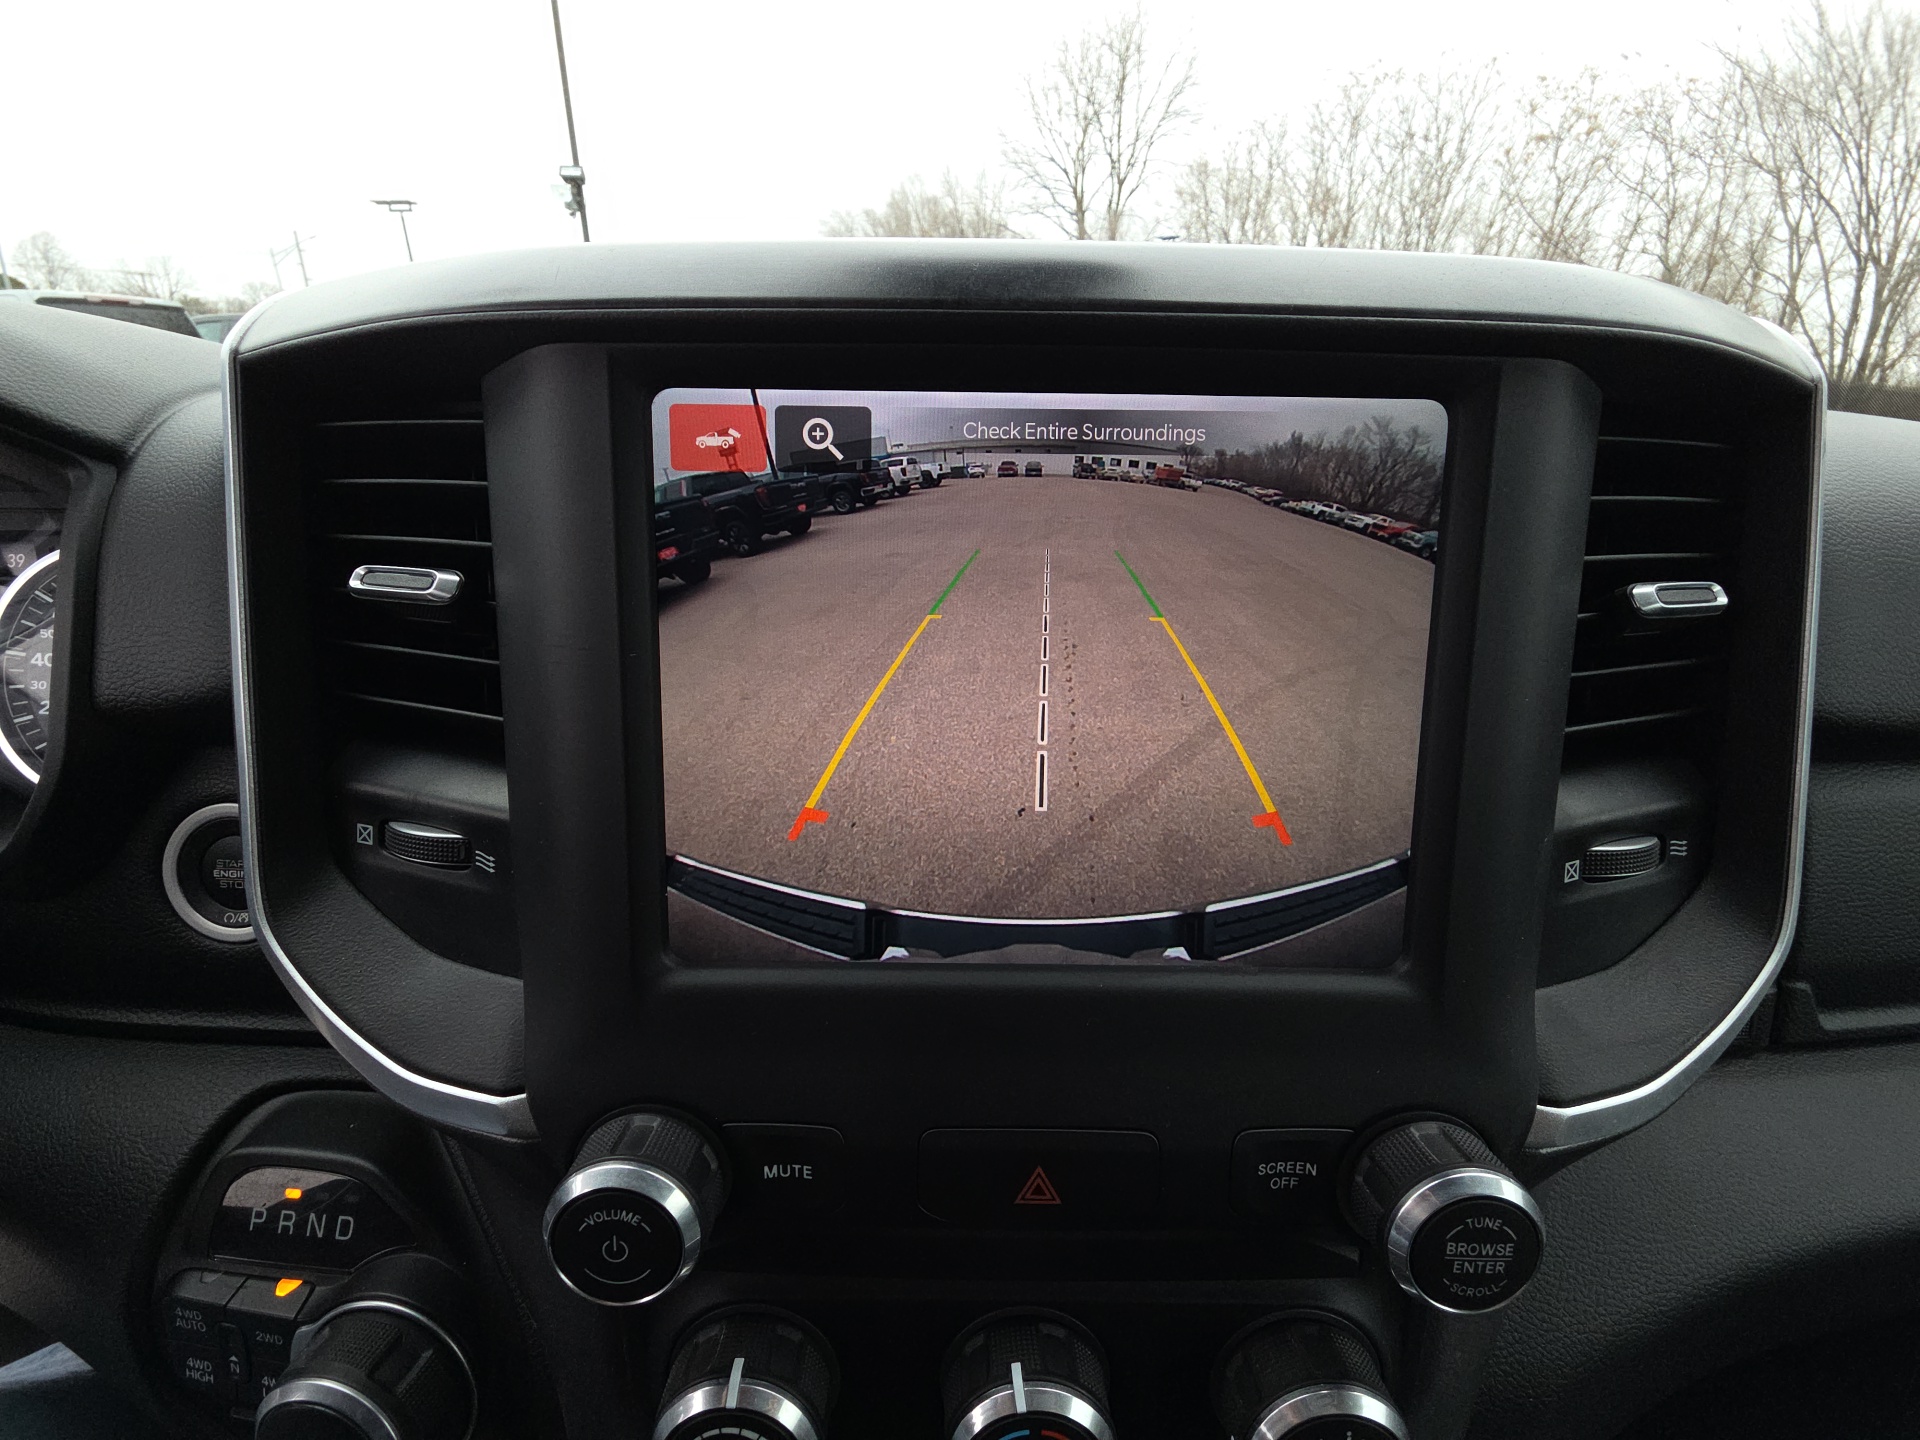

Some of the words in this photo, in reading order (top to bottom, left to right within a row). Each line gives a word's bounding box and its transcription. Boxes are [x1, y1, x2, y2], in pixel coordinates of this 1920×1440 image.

[963, 421, 1021, 439] Check
[1025, 422, 1078, 440] Entire
[1082, 423, 1206, 445] Surroundings
[7, 553, 25, 568] 39
[30, 680, 47, 690] 30
[39, 700, 50, 714] 2
[216, 859, 244, 868] STAR
[213, 870, 244, 878] ENGI
[220, 880, 244, 889] STO
[763, 1164, 813, 1180] MUTE
[1257, 1161, 1317, 1176] SCREEN
[1270, 1177, 1299, 1190] OFF
[585, 1209, 642, 1227] VOLUME
[1465, 1217, 1502, 1231] TUNE
[1446, 1242, 1514, 1256] BROWSE
[1452, 1261, 1505, 1275] ENTER
[1450, 1282, 1501, 1297] SCROLL
[175, 1306, 202, 1321] 4WD
[175, 1317, 207, 1333] AUTO
[255, 1330, 284, 1346] 2WD
[186, 1356, 212, 1372] 4WD
[230, 1362, 240, 1374] N
[185, 1369, 214, 1385] HIGH
[261, 1375, 277, 1388] 4W
